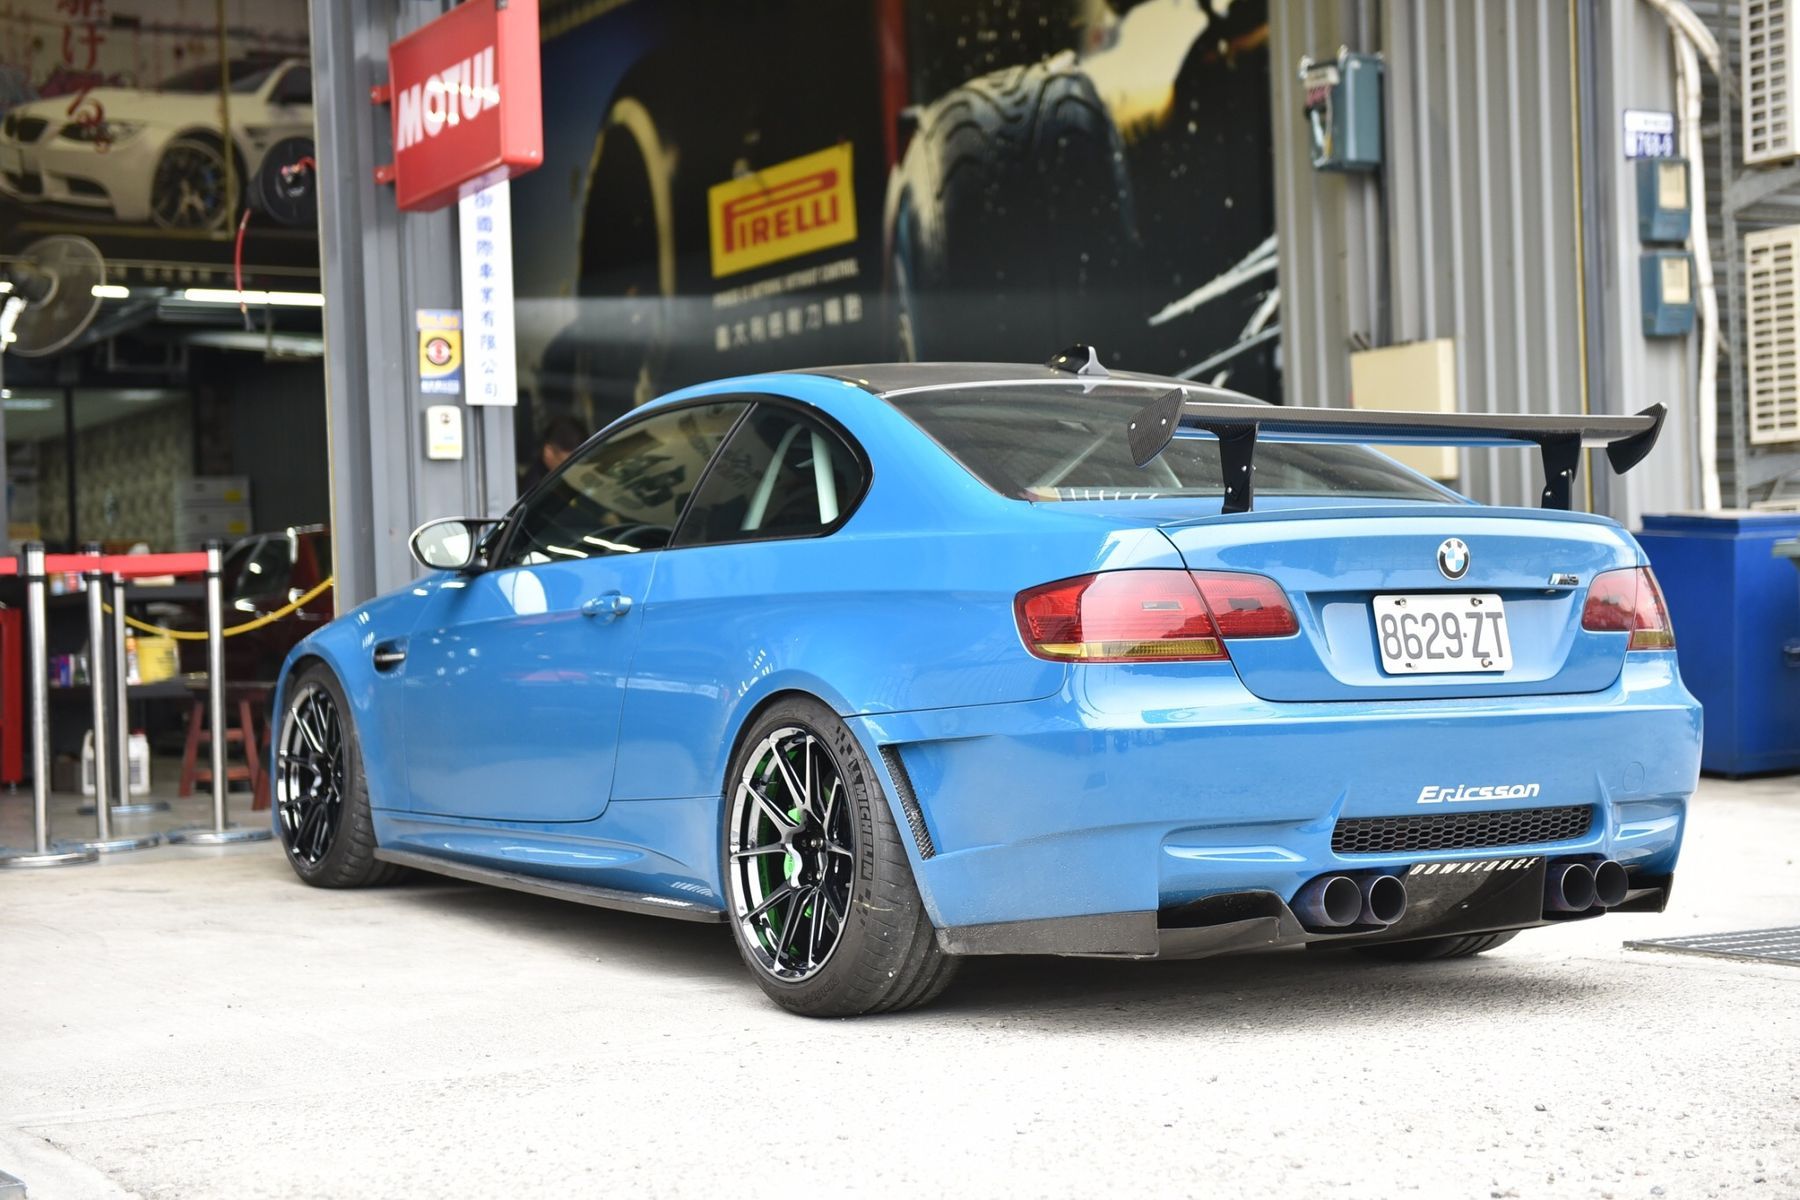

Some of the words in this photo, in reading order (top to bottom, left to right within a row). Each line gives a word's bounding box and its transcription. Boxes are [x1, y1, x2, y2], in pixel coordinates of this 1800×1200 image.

[397, 45, 500, 151] MOTUL
[721, 167, 839, 254] PIRELLI
[854, 785, 874, 880] MICHELIN
[1417, 783, 1540, 804] Ericsson
[1409, 857, 1539, 876] DOWNFORCE
